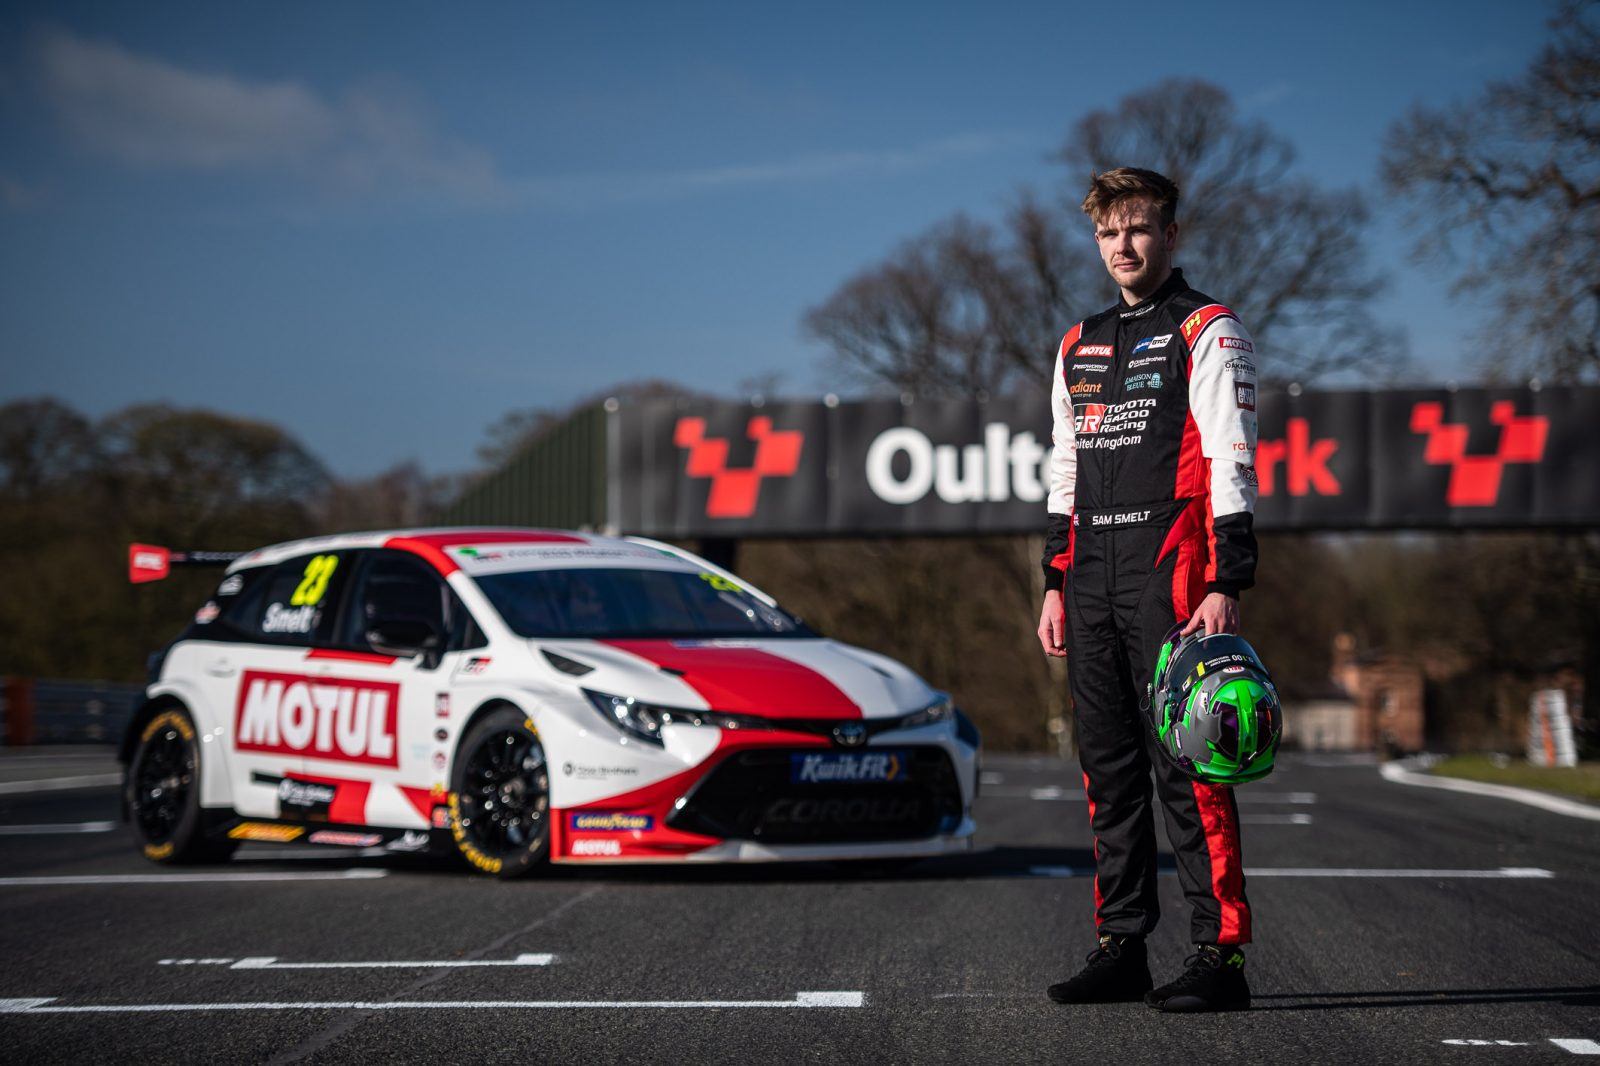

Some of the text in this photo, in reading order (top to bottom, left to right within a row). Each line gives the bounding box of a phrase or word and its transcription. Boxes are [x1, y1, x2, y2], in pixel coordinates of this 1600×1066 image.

[1185, 312, 1200, 337] P1
[1079, 346, 1112, 355] MOTUL
[1069, 381, 1102, 394] adiant
[1126, 381, 1145, 391] BLEUE
[1107, 399, 1157, 414] TOYOTA
[1075, 415, 1101, 432] GR
[1104, 409, 1149, 424] GAZOO
[1100, 420, 1147, 433] Racing
[1075, 435, 1142, 450] nited Kingdom
[866, 417, 1343, 504] Oult rk
[1092, 511, 1151, 525] SAM SMELT
[290, 554, 339, 606] 23
[262, 602, 316, 633] Smelt
[239, 678, 394, 759] MOTUL
